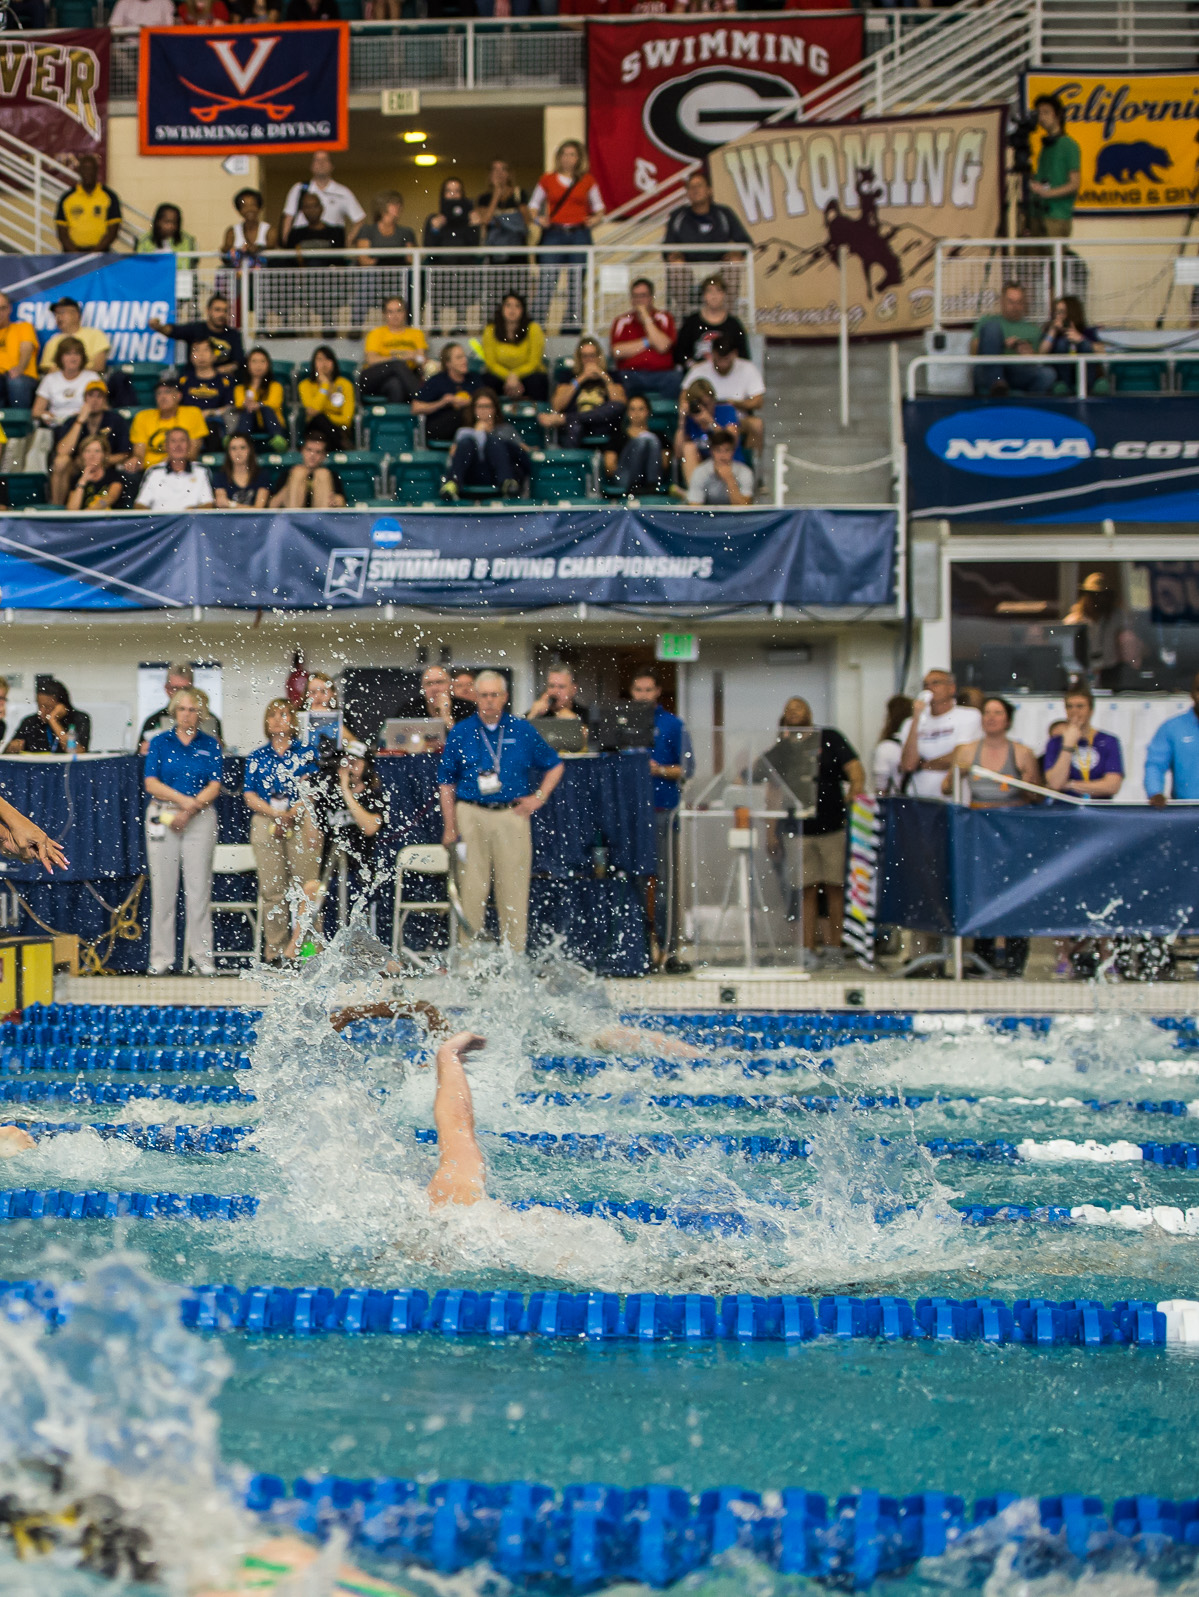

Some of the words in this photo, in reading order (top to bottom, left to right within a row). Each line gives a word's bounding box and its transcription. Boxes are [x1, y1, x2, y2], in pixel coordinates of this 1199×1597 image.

[206, 36, 282, 95] V
[621, 28, 830, 83] SWIMMING
[155, 124, 249, 141] SWIMMING
[251, 122, 265, 138] &
[267, 120, 331, 138] DIVING
[1052, 82, 1199, 141] aliforni
[724, 126, 987, 224] WYOMING
[17, 301, 170, 331] SWMMING
[108, 332, 169, 362] VING
[367, 557, 471, 580] SWIMMING
[473, 557, 490, 580] &
[491, 556, 558, 579] DIVING
[558, 556, 714, 579] CHAMPIONSHIPS
